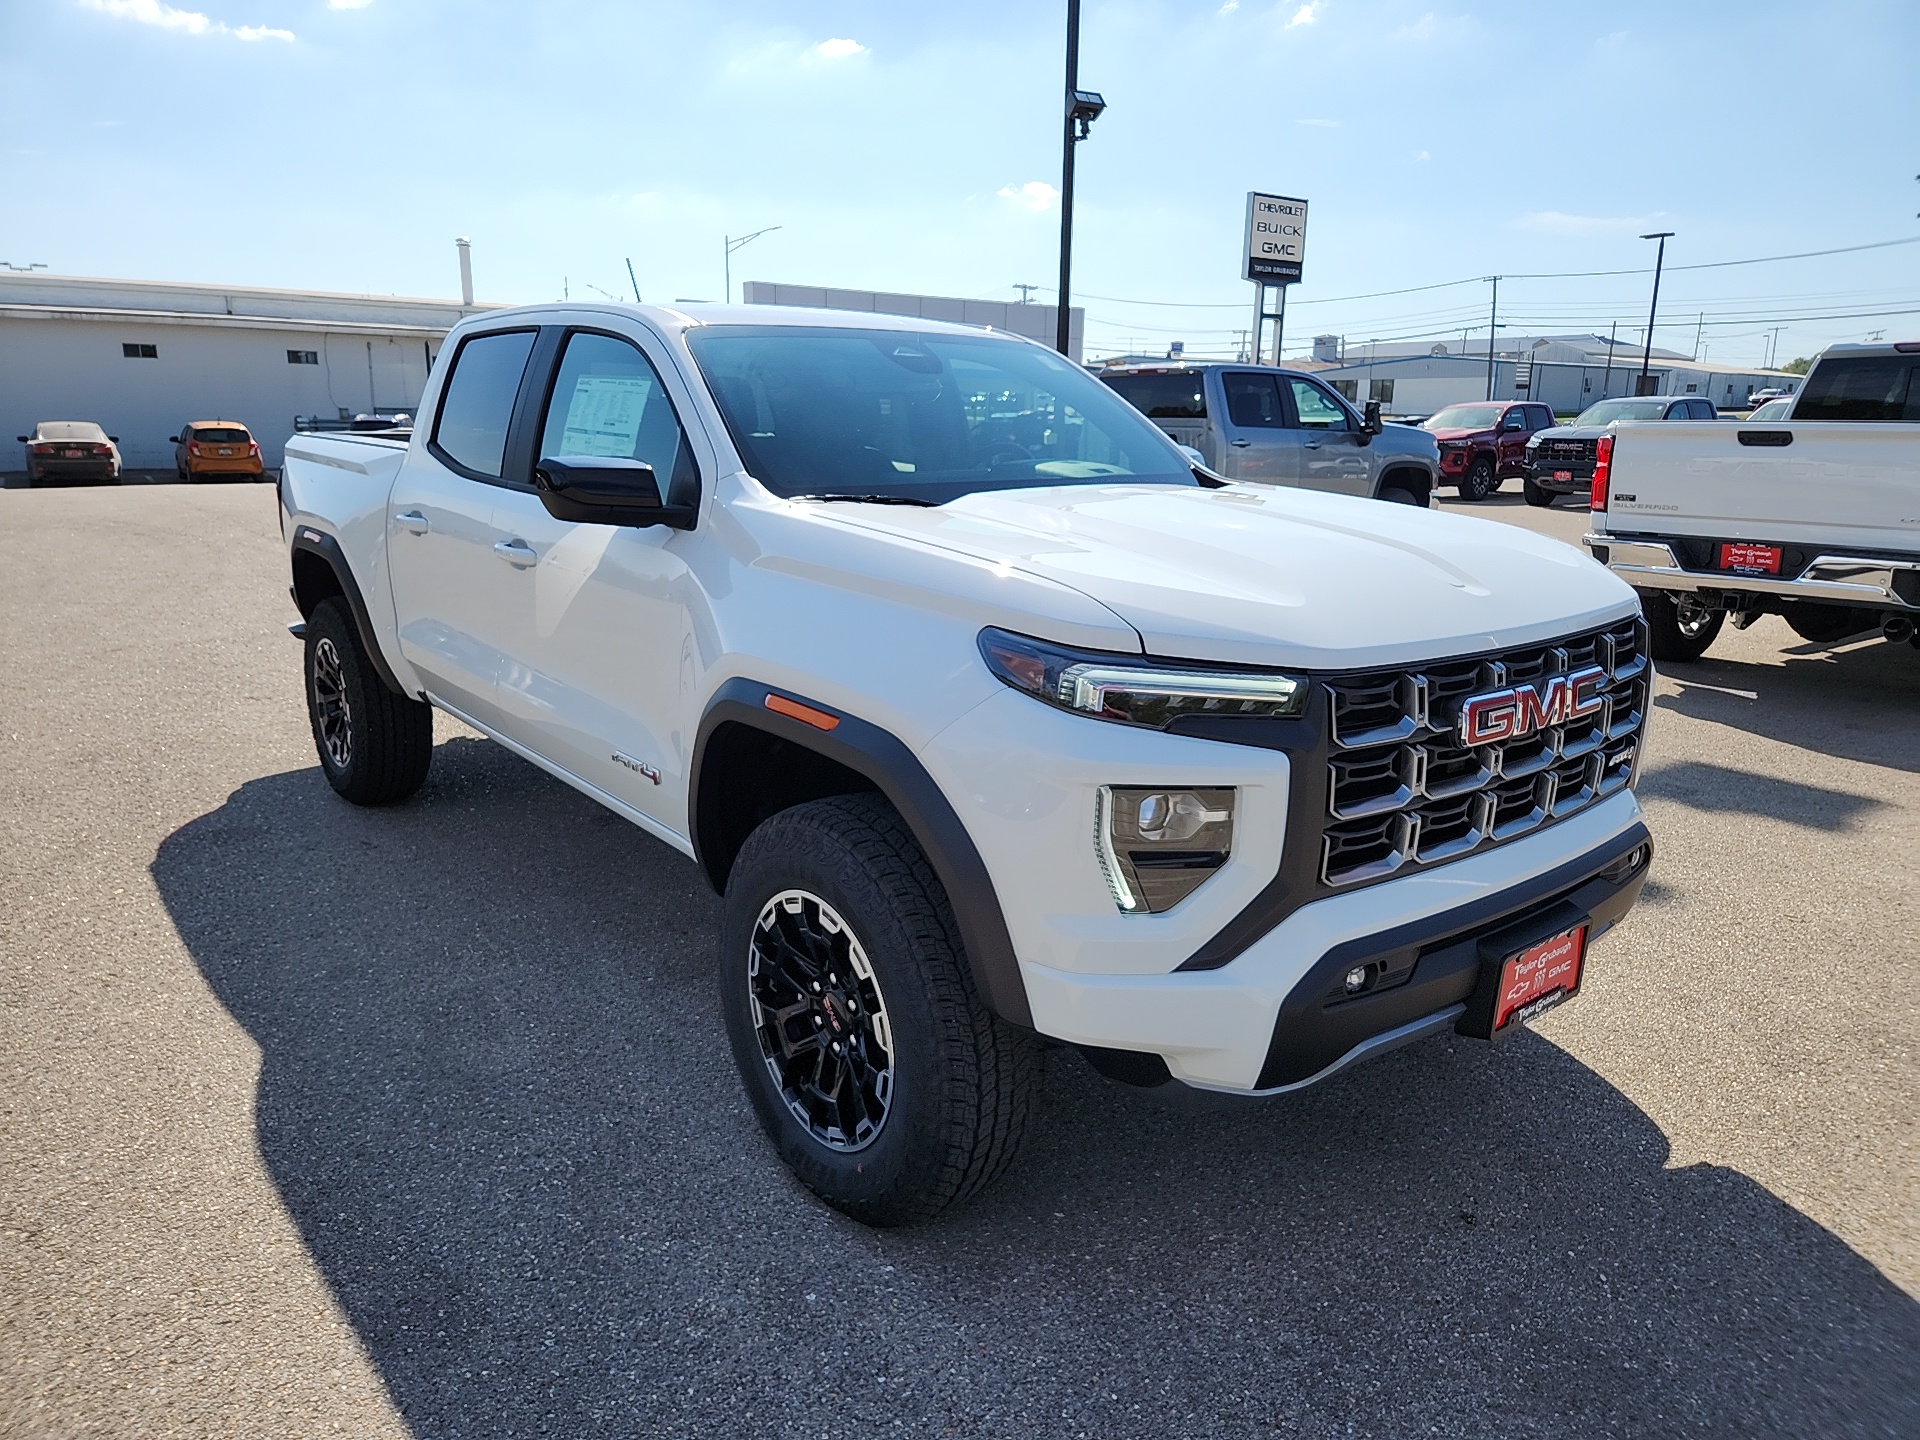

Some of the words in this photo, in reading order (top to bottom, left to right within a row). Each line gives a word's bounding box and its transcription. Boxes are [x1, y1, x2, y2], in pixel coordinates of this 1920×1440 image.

[1259, 202, 1304, 217] CHEVROLET
[1257, 222, 1302, 237] BUICK
[1262, 242, 1295, 256] GMC
[1254, 265, 1272, 273] TAYLOR
[1613, 502, 1679, 511] SILVERADO
[1461, 664, 1610, 748] GMC
[1514, 959, 1538, 981] Taylor
[1537, 941, 1572, 969] Grubaugh
[1548, 959, 1572, 979] GMC
[823, 995, 841, 1032] GMC
[1518, 1003, 1536, 1022] Taylor
[1535, 989, 1562, 1013] Grubaugh
